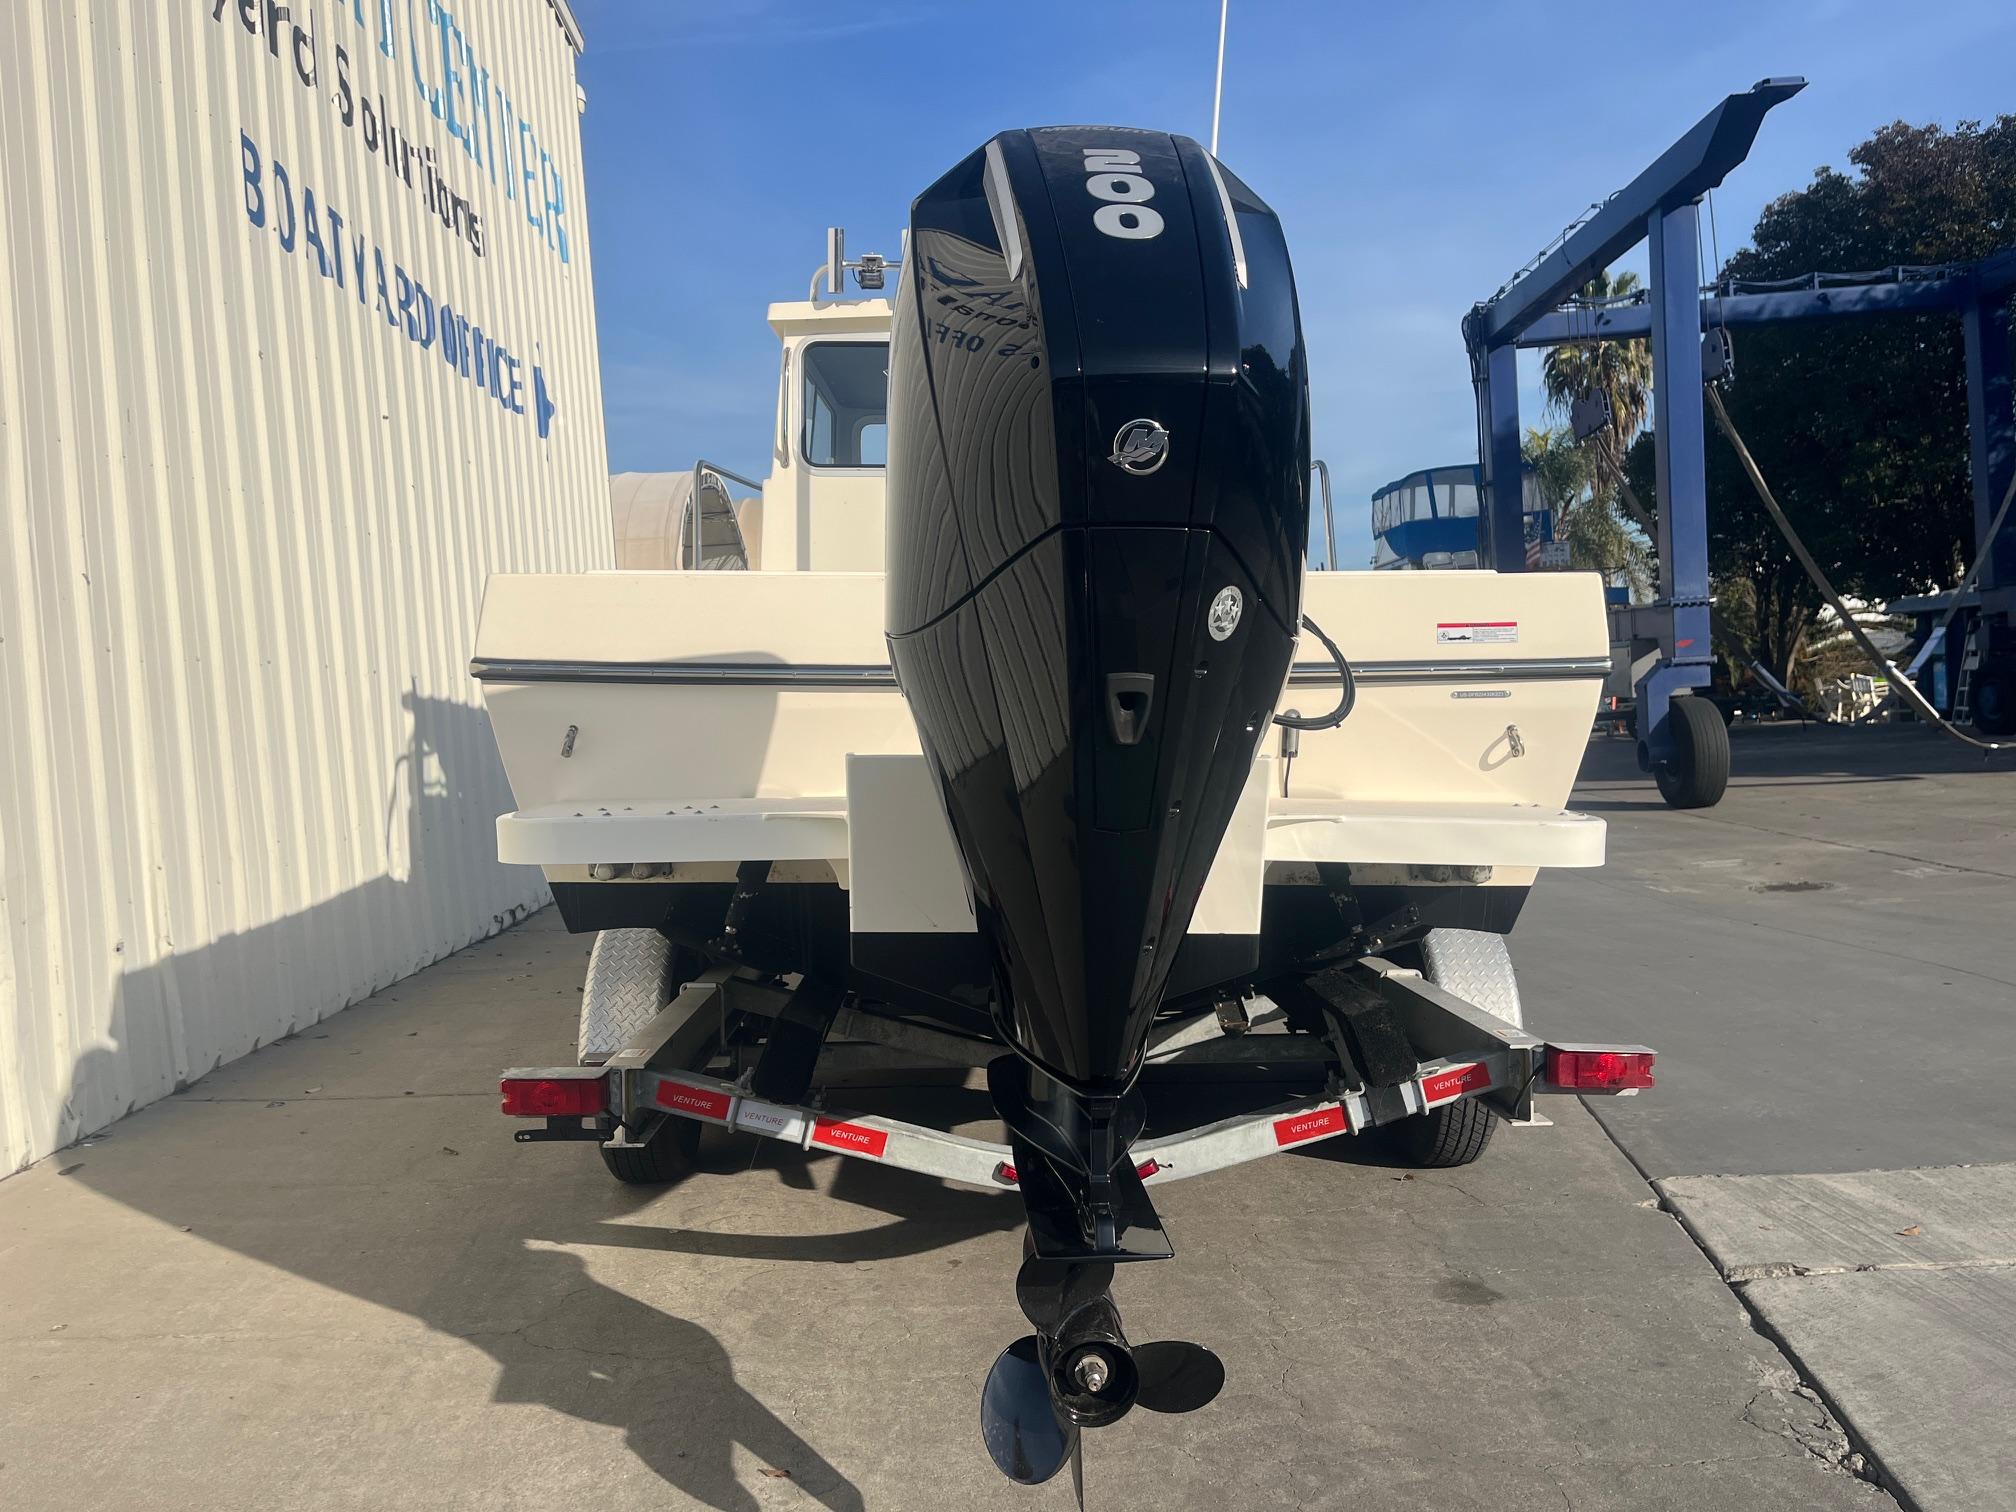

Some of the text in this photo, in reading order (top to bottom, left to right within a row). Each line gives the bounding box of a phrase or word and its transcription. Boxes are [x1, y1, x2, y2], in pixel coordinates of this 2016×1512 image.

[408, 0, 569, 263] CENTER
[331, 43, 486, 258] Solutions
[1082, 148, 1165, 240] 200
[440, 304, 524, 415] OFFICE
[1433, 1073, 1473, 1091] VENTURE
[672, 1093, 713, 1110] VENTURE
[743, 1111, 784, 1127] VENTURE
[1290, 1116, 1330, 1134] VENTURE
[830, 1128, 871, 1145] VENTURE
